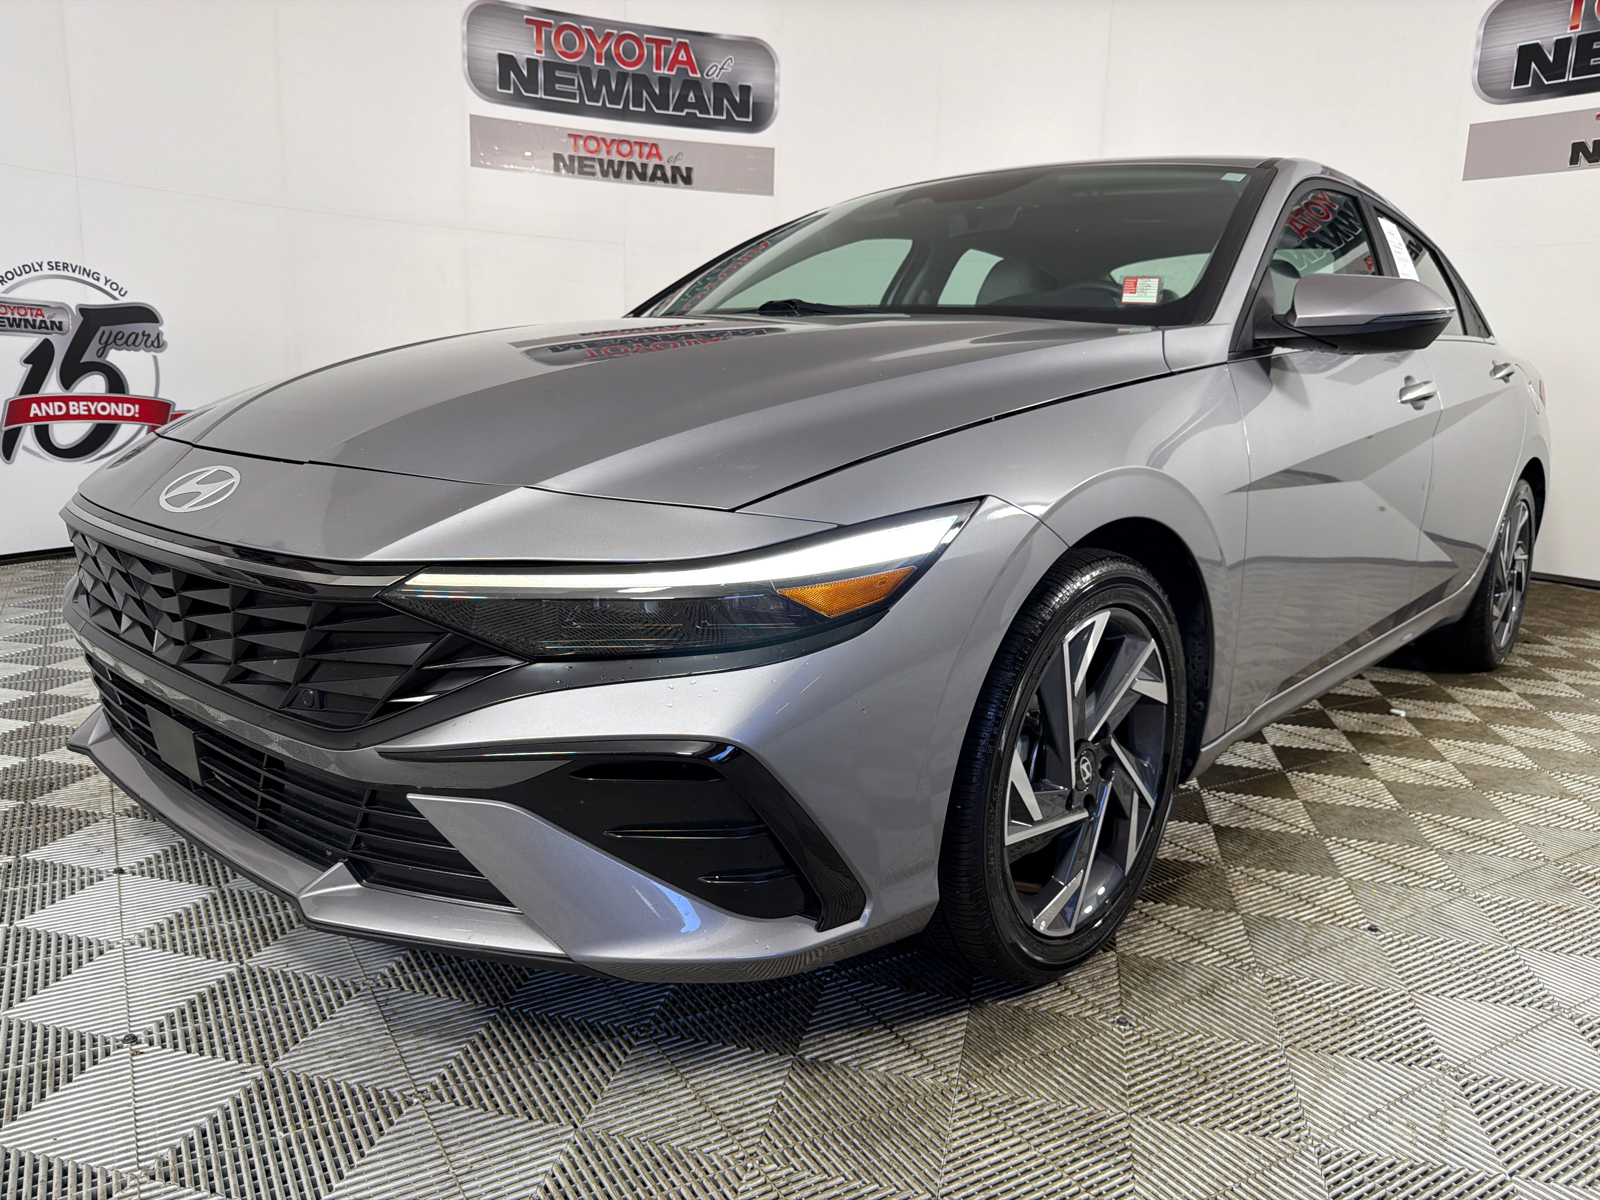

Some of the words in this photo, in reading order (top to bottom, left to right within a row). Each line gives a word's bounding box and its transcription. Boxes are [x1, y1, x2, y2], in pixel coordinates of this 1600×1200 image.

[524, 17, 699, 76] TOYOTA
[704, 57, 734, 81] of
[497, 53, 752, 121] NEWNAN
[568, 133, 663, 161] TOYOTA
[667, 152, 684, 164] of
[552, 153, 693, 186] NEWNAN
[0, 261, 43, 286] ROUDLY
[47, 261, 101, 282] SERVING
[103, 276, 128, 297] YOU
[0, 304, 45, 319] OYOTA
[0, 316, 63, 332] EWNAN
[2, 305, 160, 462] 15
[96, 329, 165, 358] years
[29, 402, 66, 418] AND
[69, 402, 140, 417] BEYOND!
